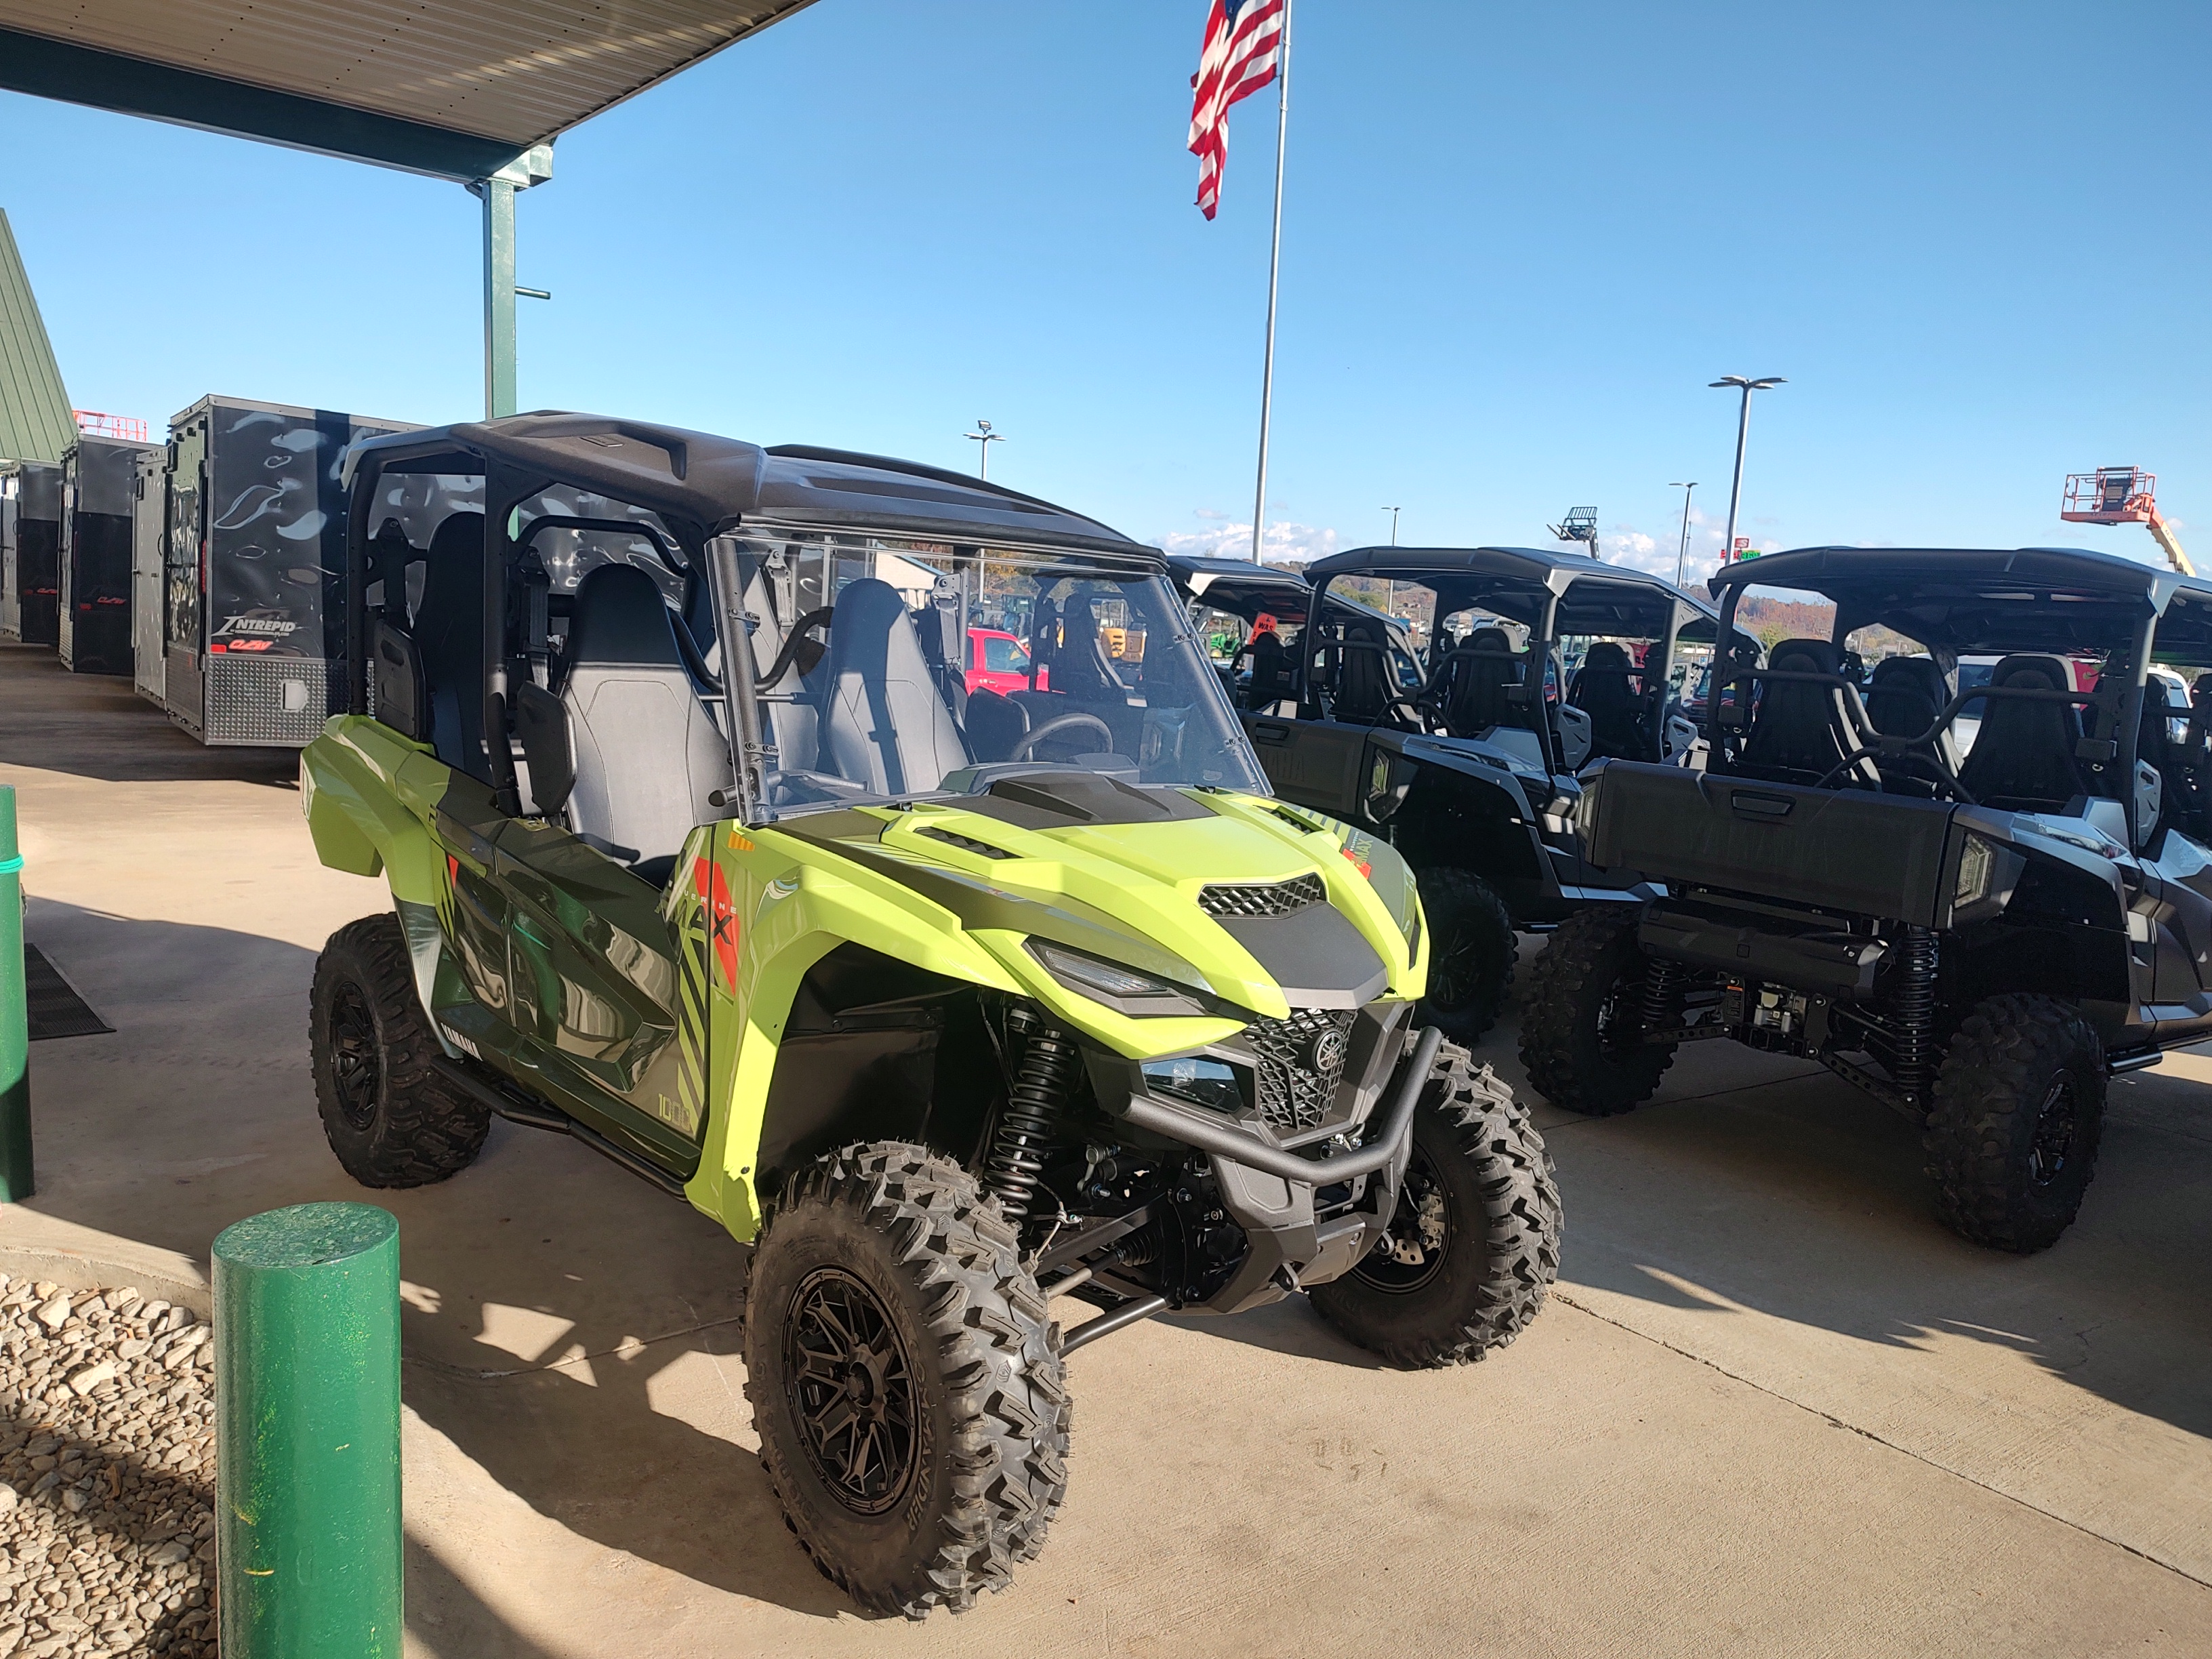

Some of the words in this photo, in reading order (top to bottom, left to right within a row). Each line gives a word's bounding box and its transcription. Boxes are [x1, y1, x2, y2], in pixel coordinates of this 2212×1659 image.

[211, 615, 296, 636] INTREPID
[440, 1022, 483, 1062] YAMAHA
[658, 1092, 691, 1132] 1000
[907, 1338, 935, 1532] COMMANDER
